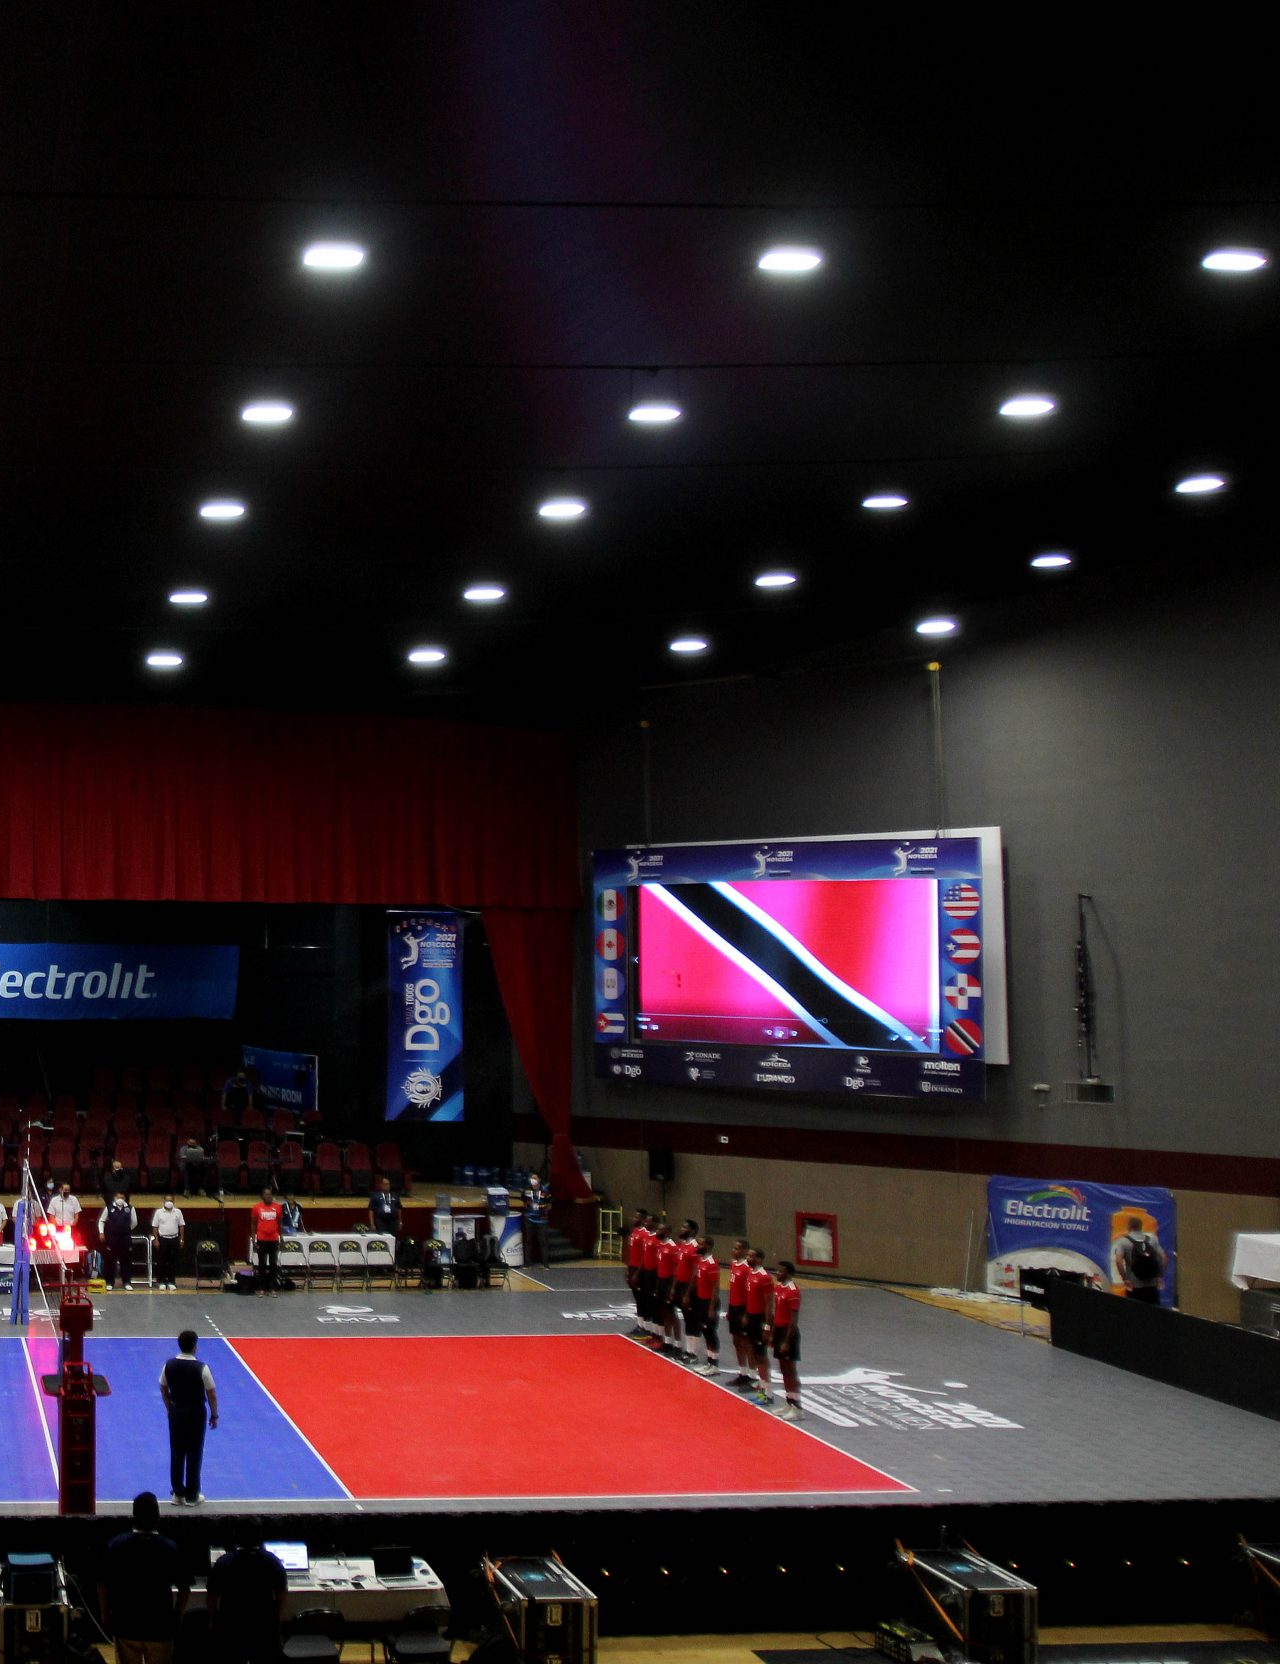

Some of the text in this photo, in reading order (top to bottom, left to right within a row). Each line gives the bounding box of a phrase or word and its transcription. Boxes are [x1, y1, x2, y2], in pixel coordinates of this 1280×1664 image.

[435, 933, 457, 941] 2021
[405, 978, 450, 1051] Dgo
[924, 1061, 961, 1071] molten
[1006, 1199, 1091, 1222] Electrolit
